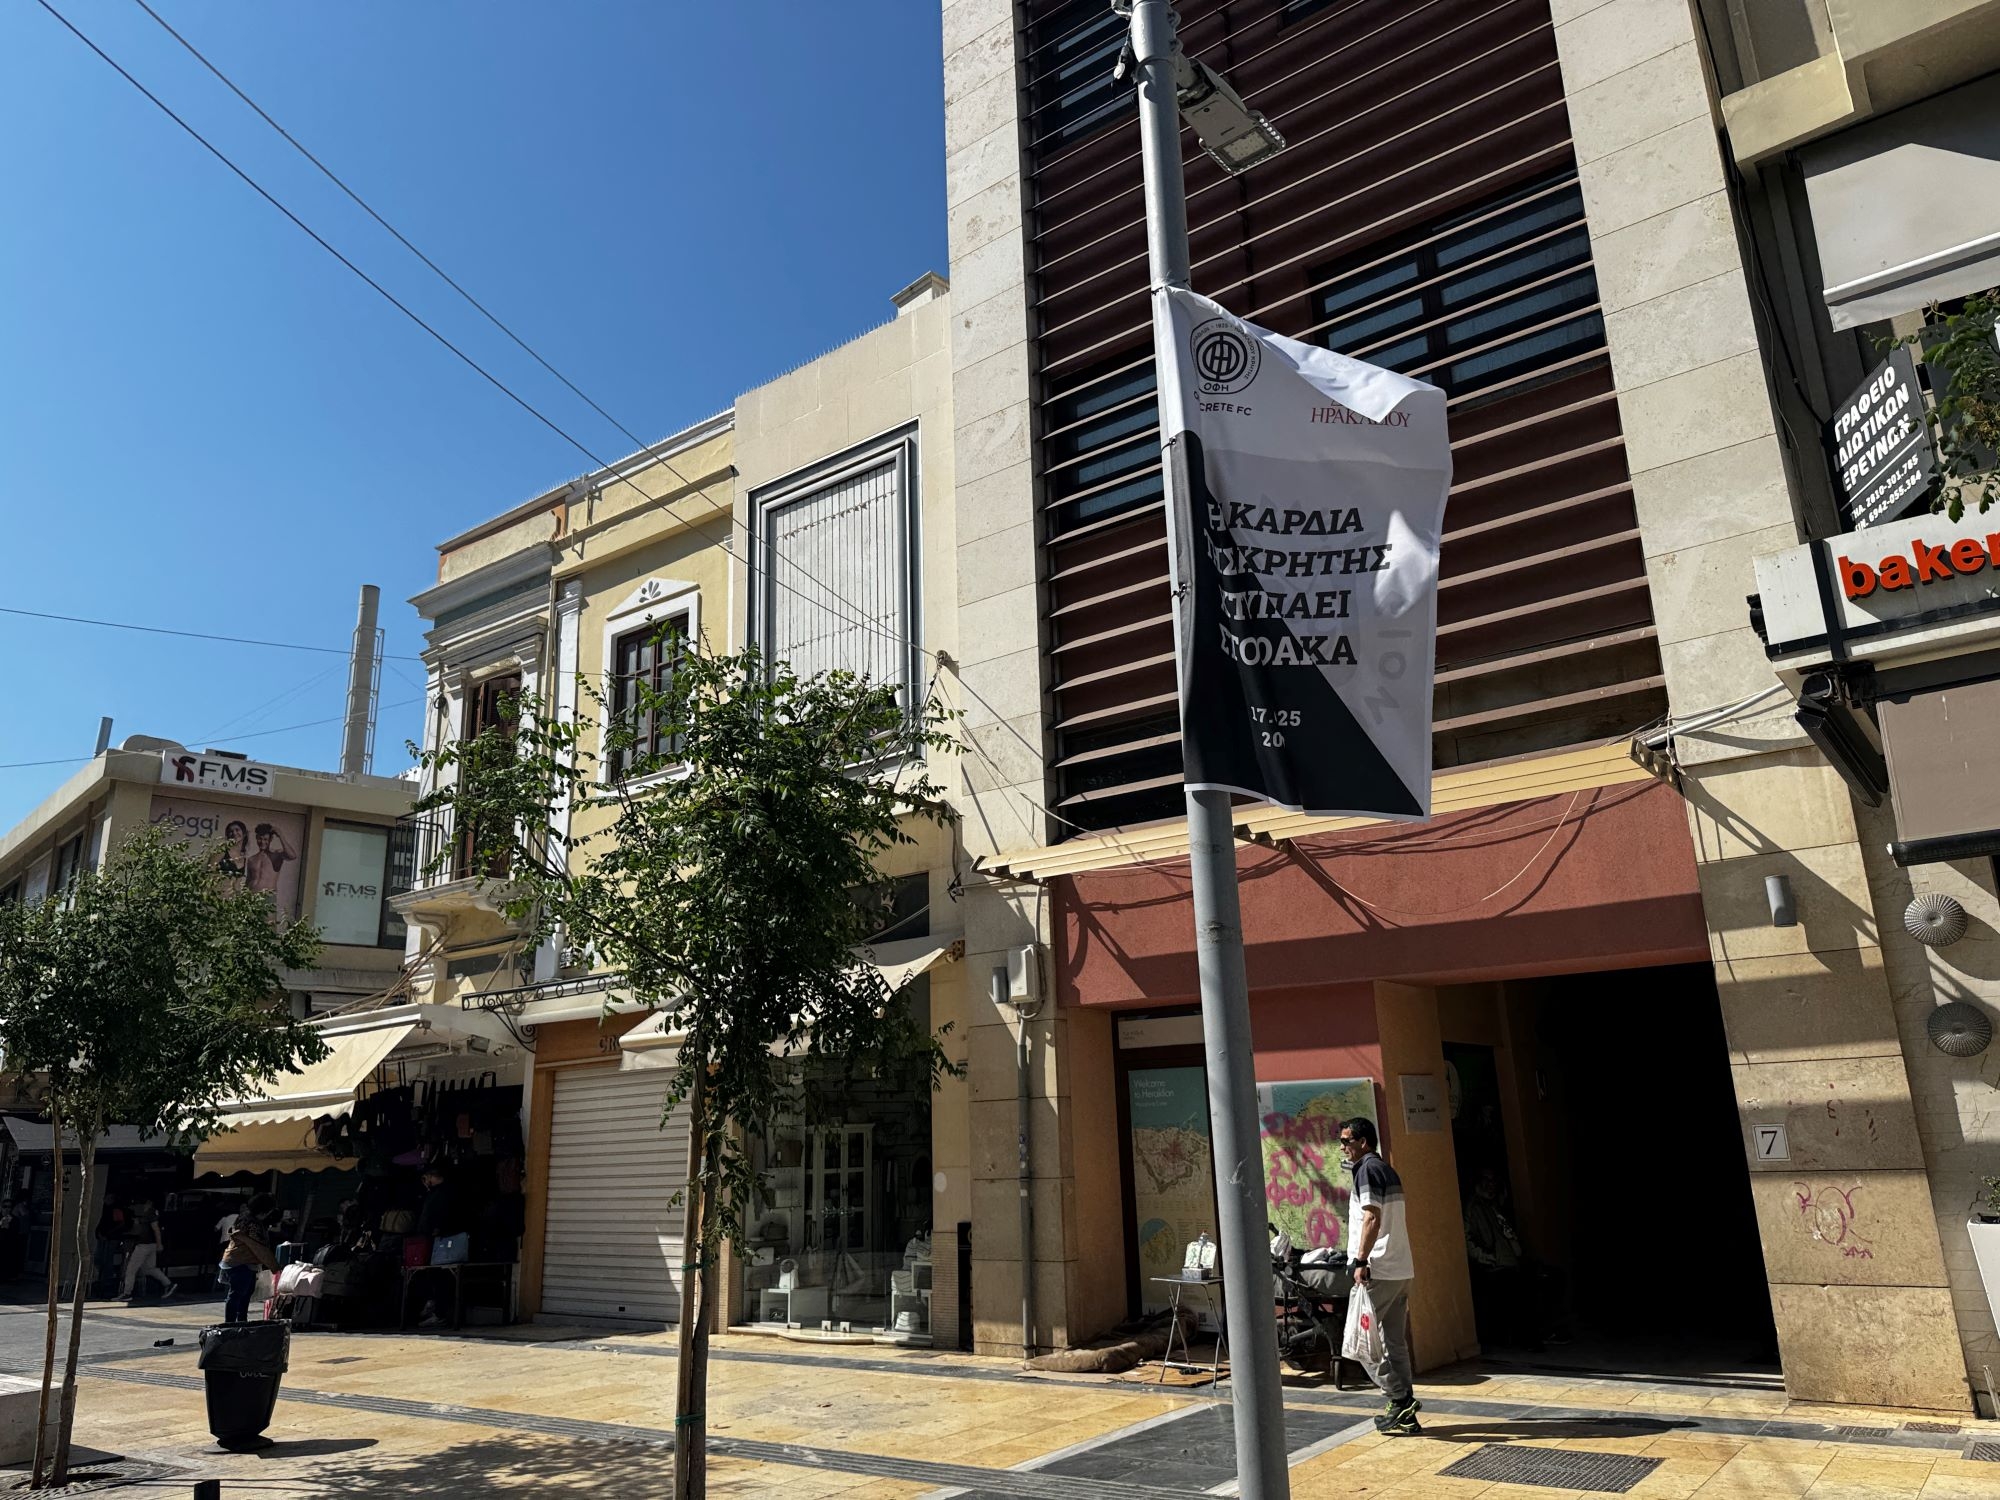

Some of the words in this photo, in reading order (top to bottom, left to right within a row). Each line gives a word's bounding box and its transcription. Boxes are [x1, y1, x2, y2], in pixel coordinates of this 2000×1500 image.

[1203, 382, 1229, 392] ΟΦΗ
[1200, 402, 1234, 412] CRETE
[1236, 406, 1252, 416] FC
[1834, 366, 1896, 442] ΓΡΑΦΕΙΟ
[1310, 407, 1412, 427] ΗΡΑΚΙΟΥ
[1228, 501, 1364, 535] ΚΑΡΔΙΑ
[1236, 543, 1392, 577] ΚΡΗΤΗΣ
[199, 761, 268, 785] FMS
[337, 883, 377, 896] FMS
[1760, 1130, 1778, 1155] 7
